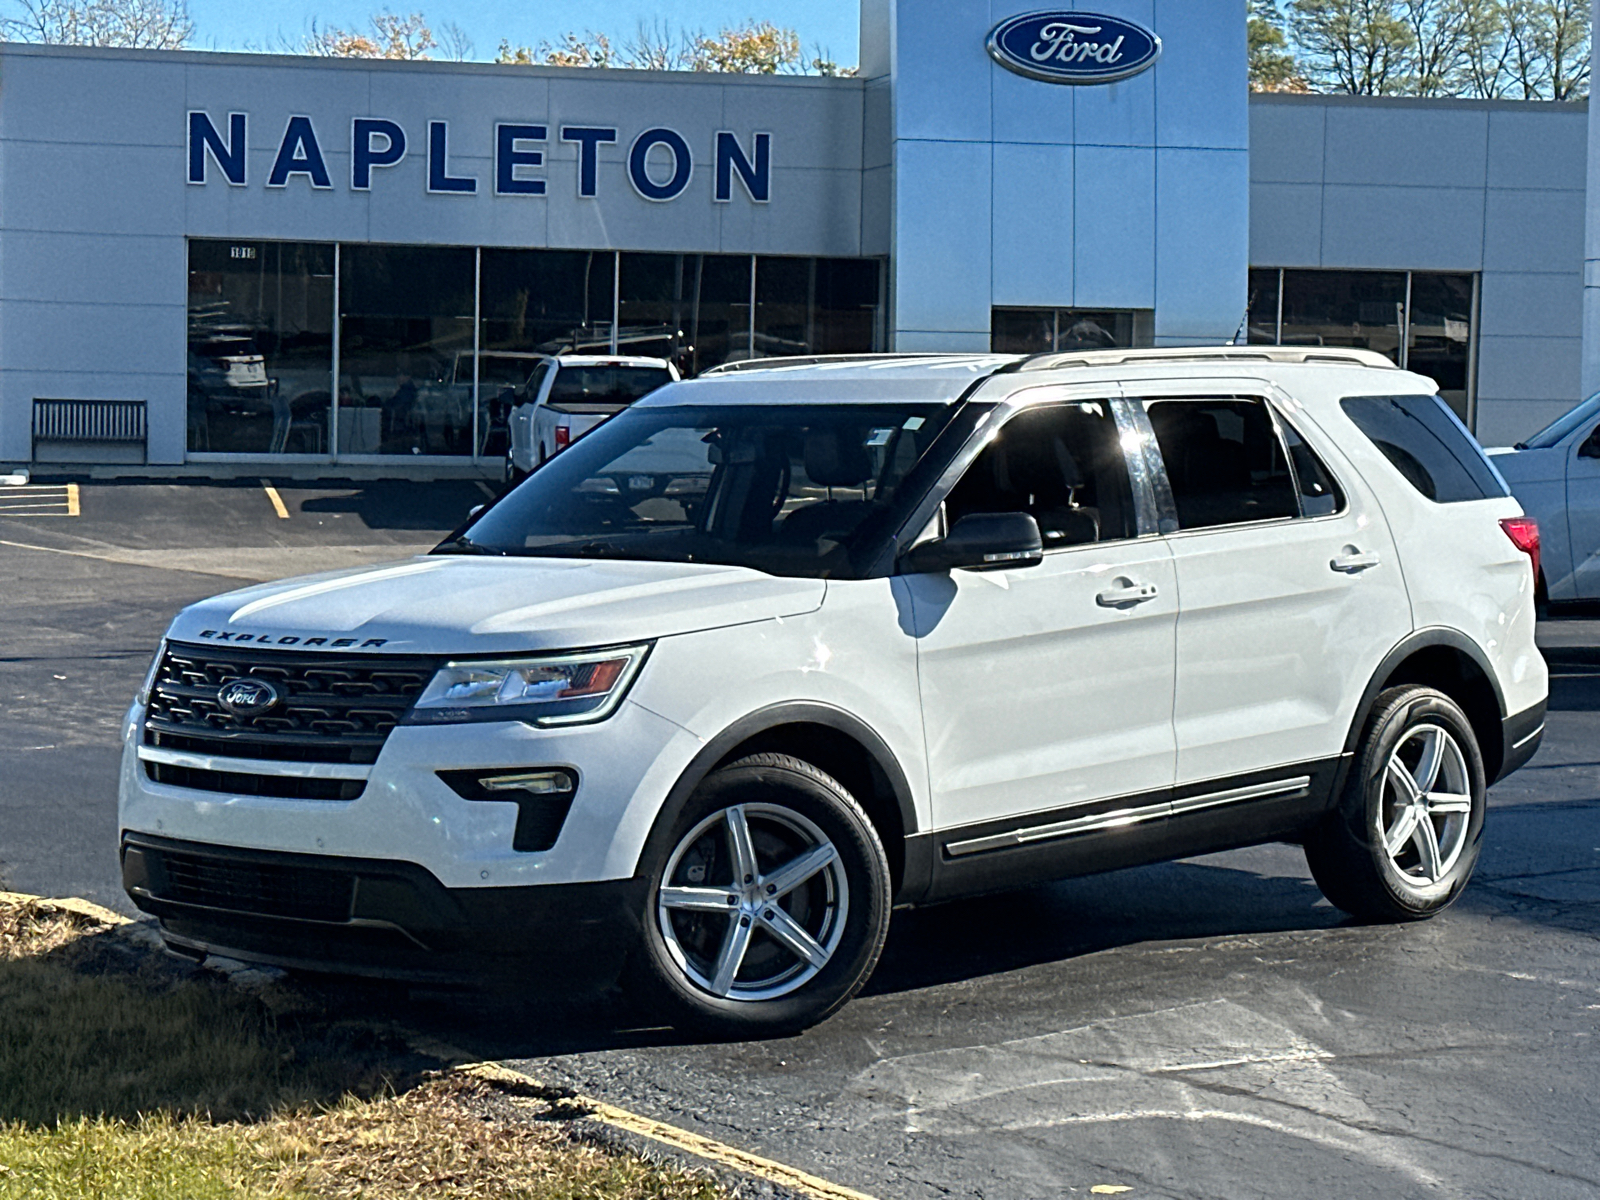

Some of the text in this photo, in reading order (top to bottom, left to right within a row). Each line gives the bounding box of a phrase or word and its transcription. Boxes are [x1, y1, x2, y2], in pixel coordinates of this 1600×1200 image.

[1030, 22, 1126, 64] Ford
[186, 110, 772, 203] NAPLETON
[199, 629, 389, 648] EXPLORER
[226, 684, 262, 705] Ford
